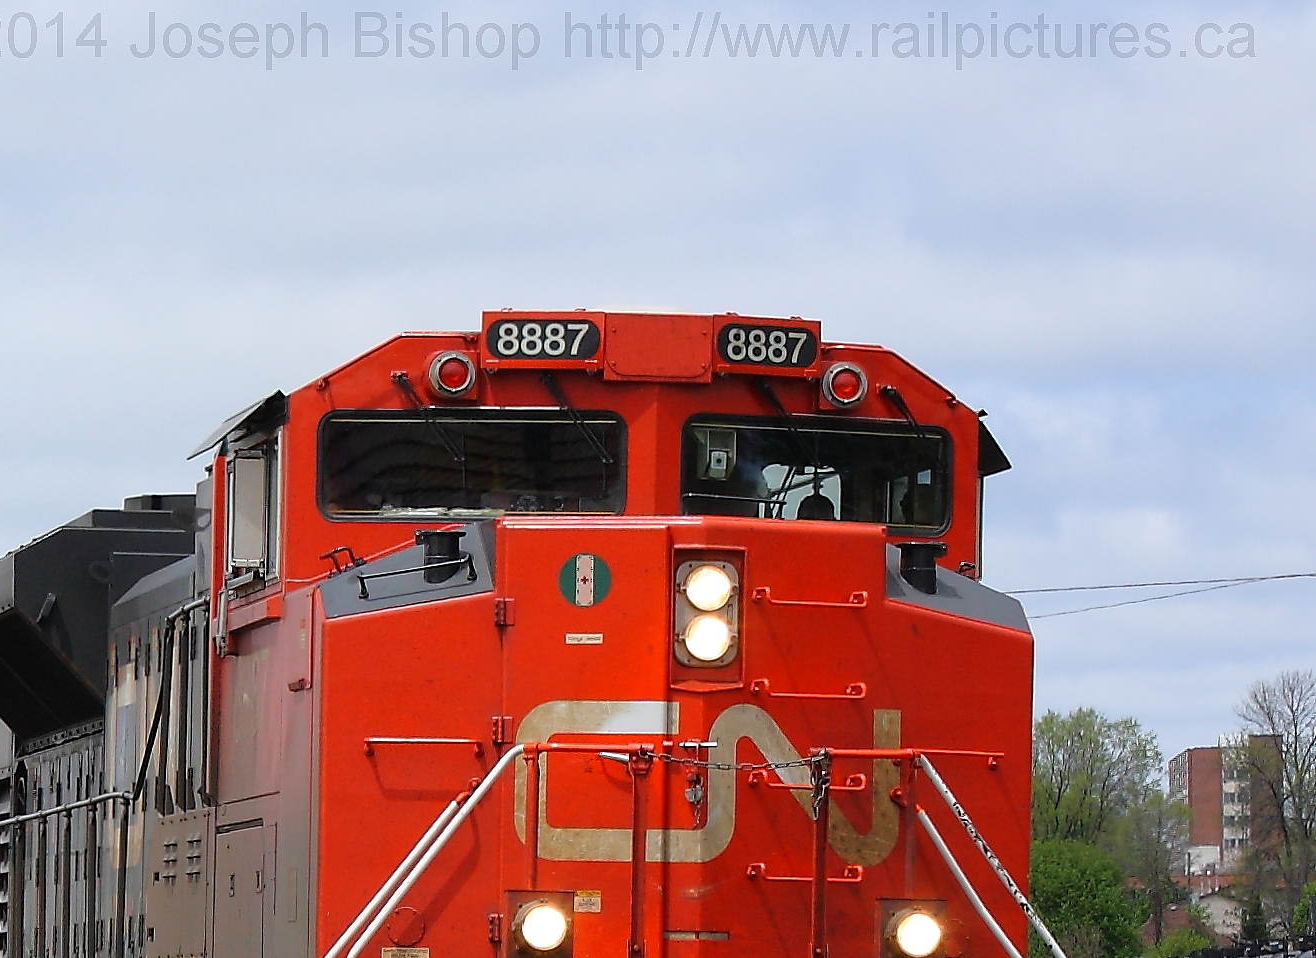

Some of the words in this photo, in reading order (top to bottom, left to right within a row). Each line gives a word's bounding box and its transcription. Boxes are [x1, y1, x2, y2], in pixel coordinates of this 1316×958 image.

[496, 322, 589, 356] 8887
[726, 327, 808, 365] 8887
[513, 700, 903, 868] CN
